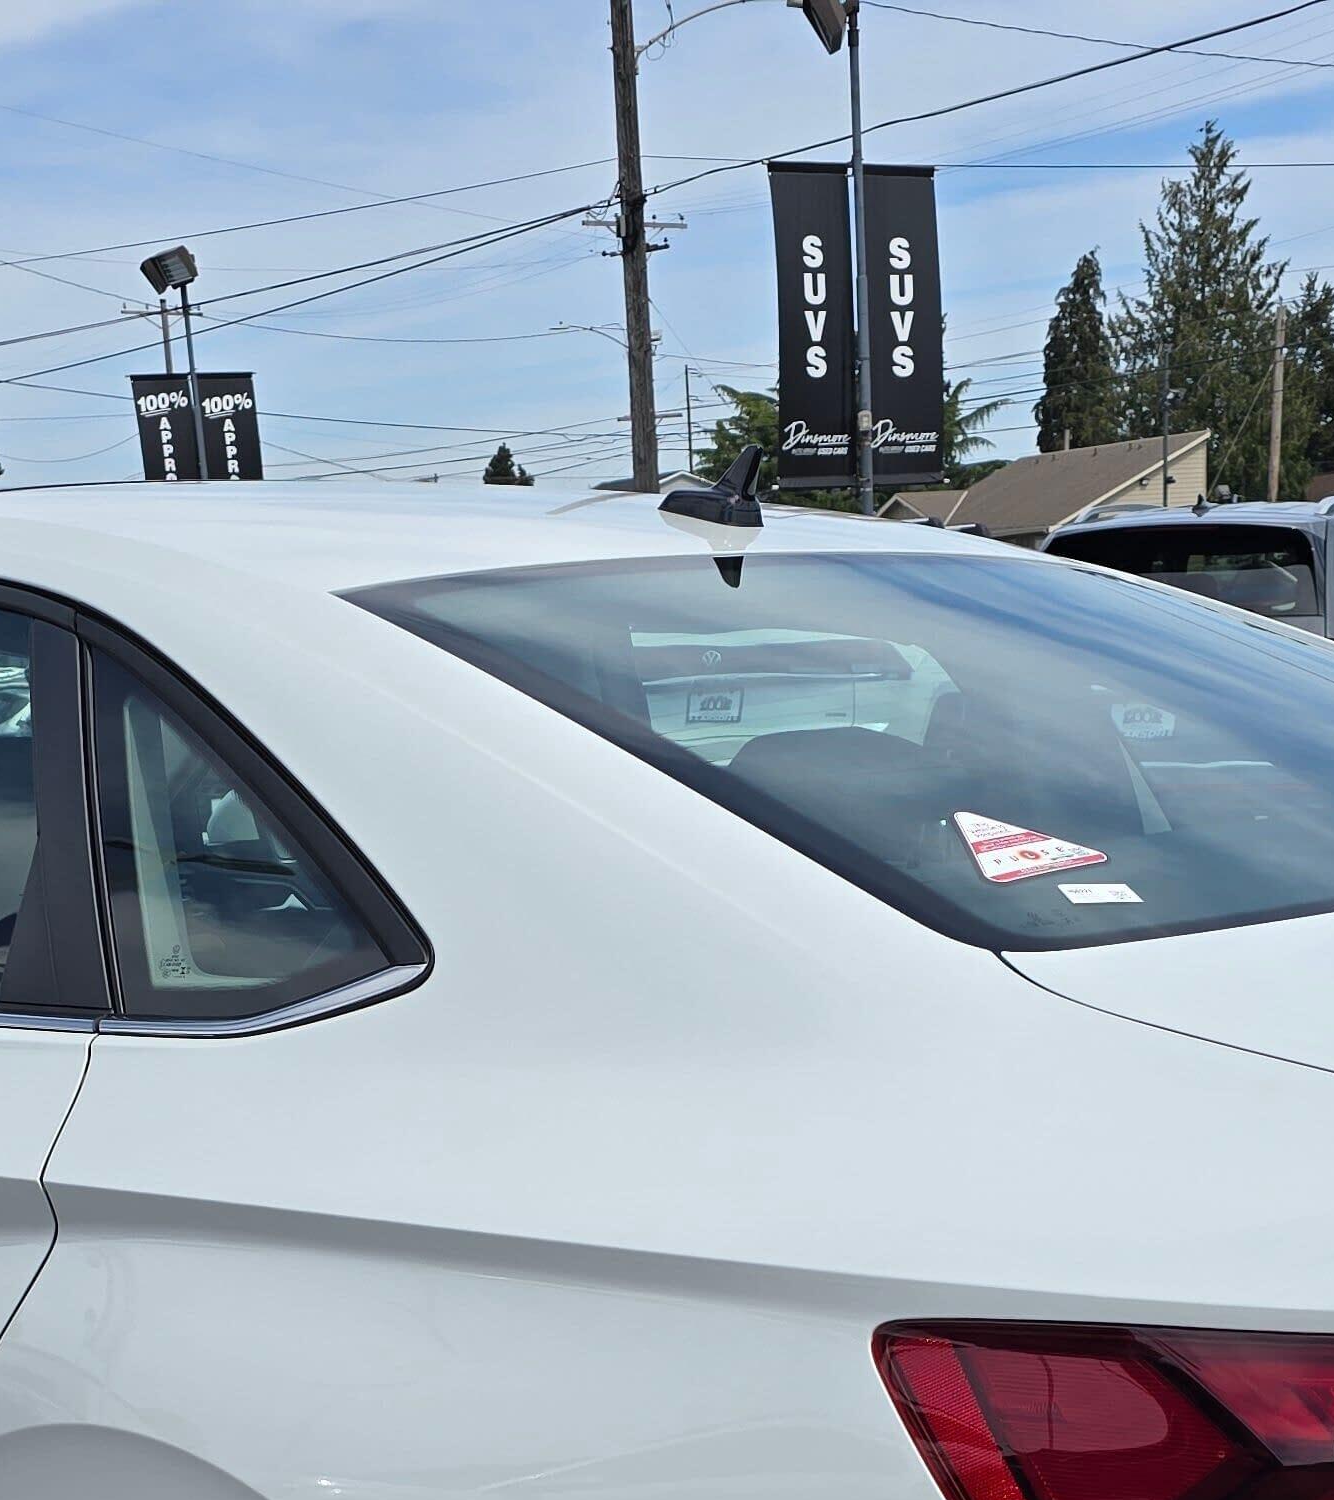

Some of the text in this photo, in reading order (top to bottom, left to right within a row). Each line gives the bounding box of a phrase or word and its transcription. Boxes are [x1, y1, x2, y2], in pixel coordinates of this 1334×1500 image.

[802, 234, 828, 379] SUVS
[889, 237, 915, 379] SUVS
[137, 390, 188, 412] 100%
[202, 392, 252, 414] 100%
[782, 420, 851, 450] Dinsmore
[870, 419, 939, 449] Dinsmore
